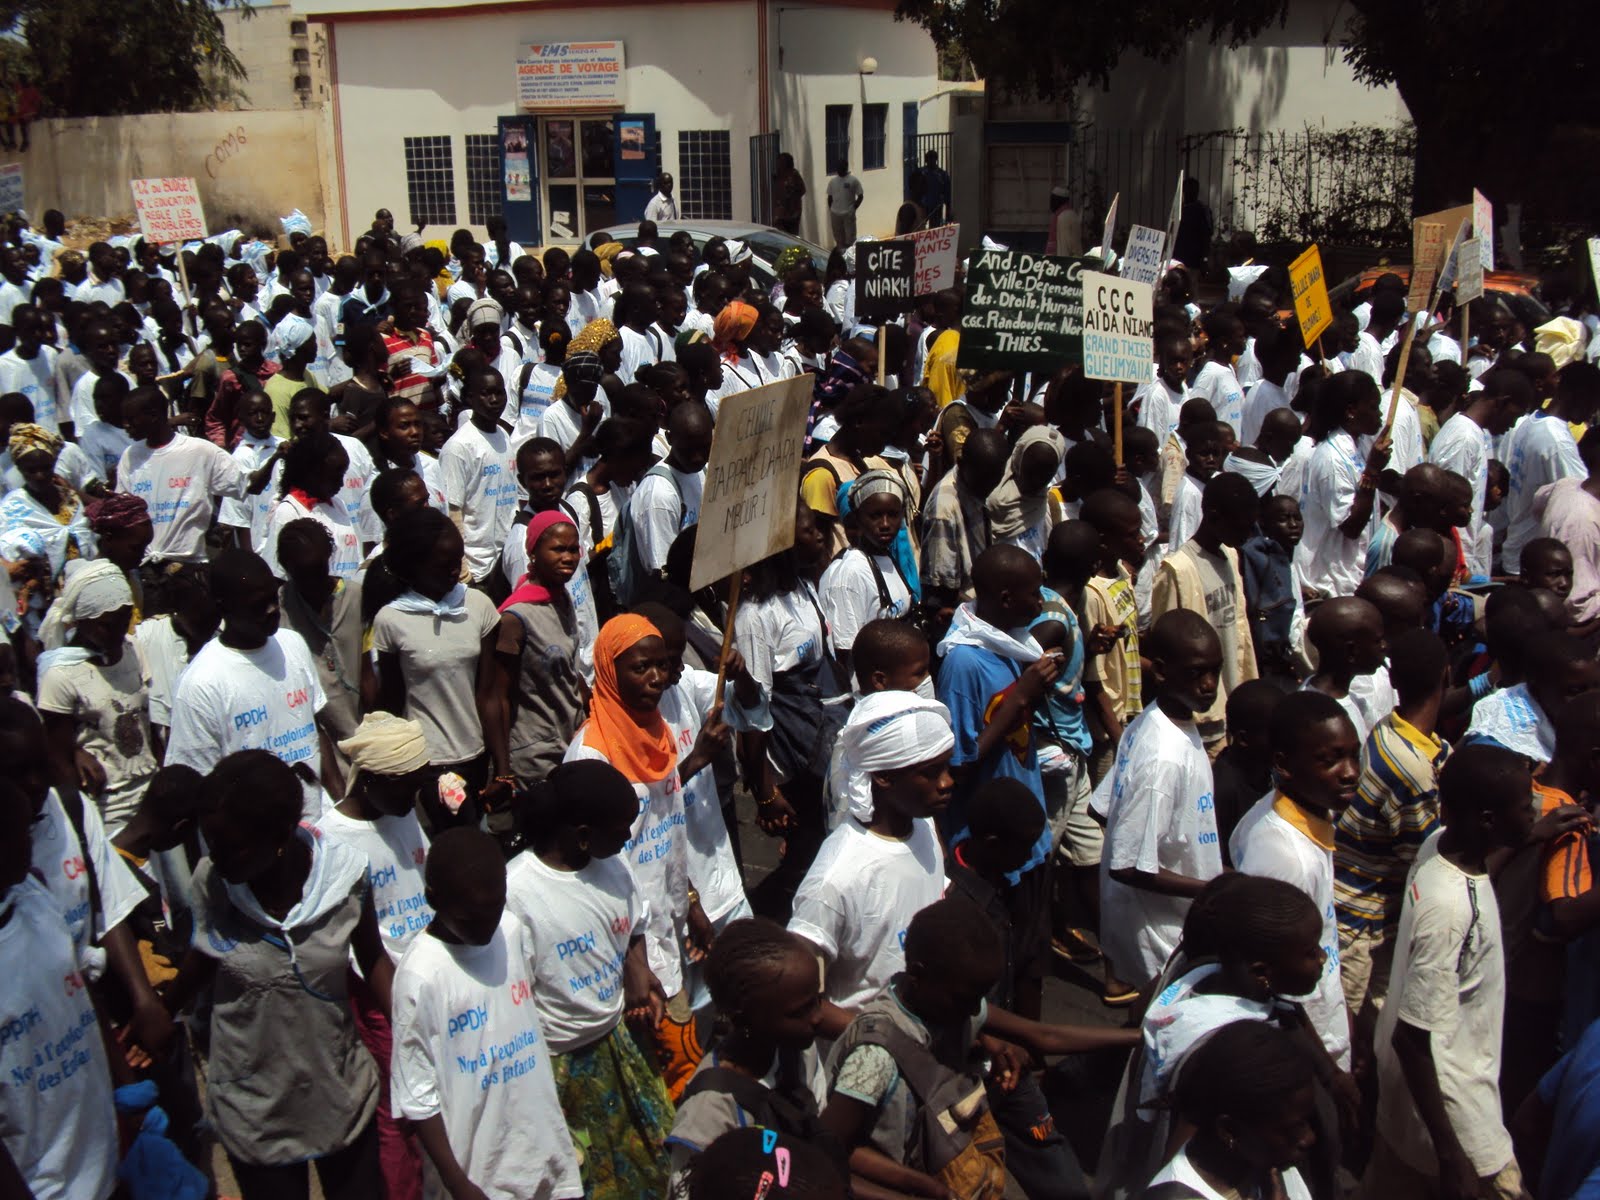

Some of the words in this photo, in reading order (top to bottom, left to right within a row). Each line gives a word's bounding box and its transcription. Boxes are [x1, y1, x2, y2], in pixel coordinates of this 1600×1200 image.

[541, 45, 569, 57] EMS
[518, 64, 554, 75] AGENCE
[560, 63, 572, 73] DE
[577, 62, 620, 73] VOYAGE
[177, 208, 192, 219] LES
[761, 438, 796, 481] DAARA
[724, 494, 758, 533] MBOUR
[234, 704, 268, 731] PPDH
[638, 849, 653, 864] des
[556, 930, 596, 960] PPDH
[569, 975, 592, 994] Non
[448, 1001, 488, 1038] PPDH
